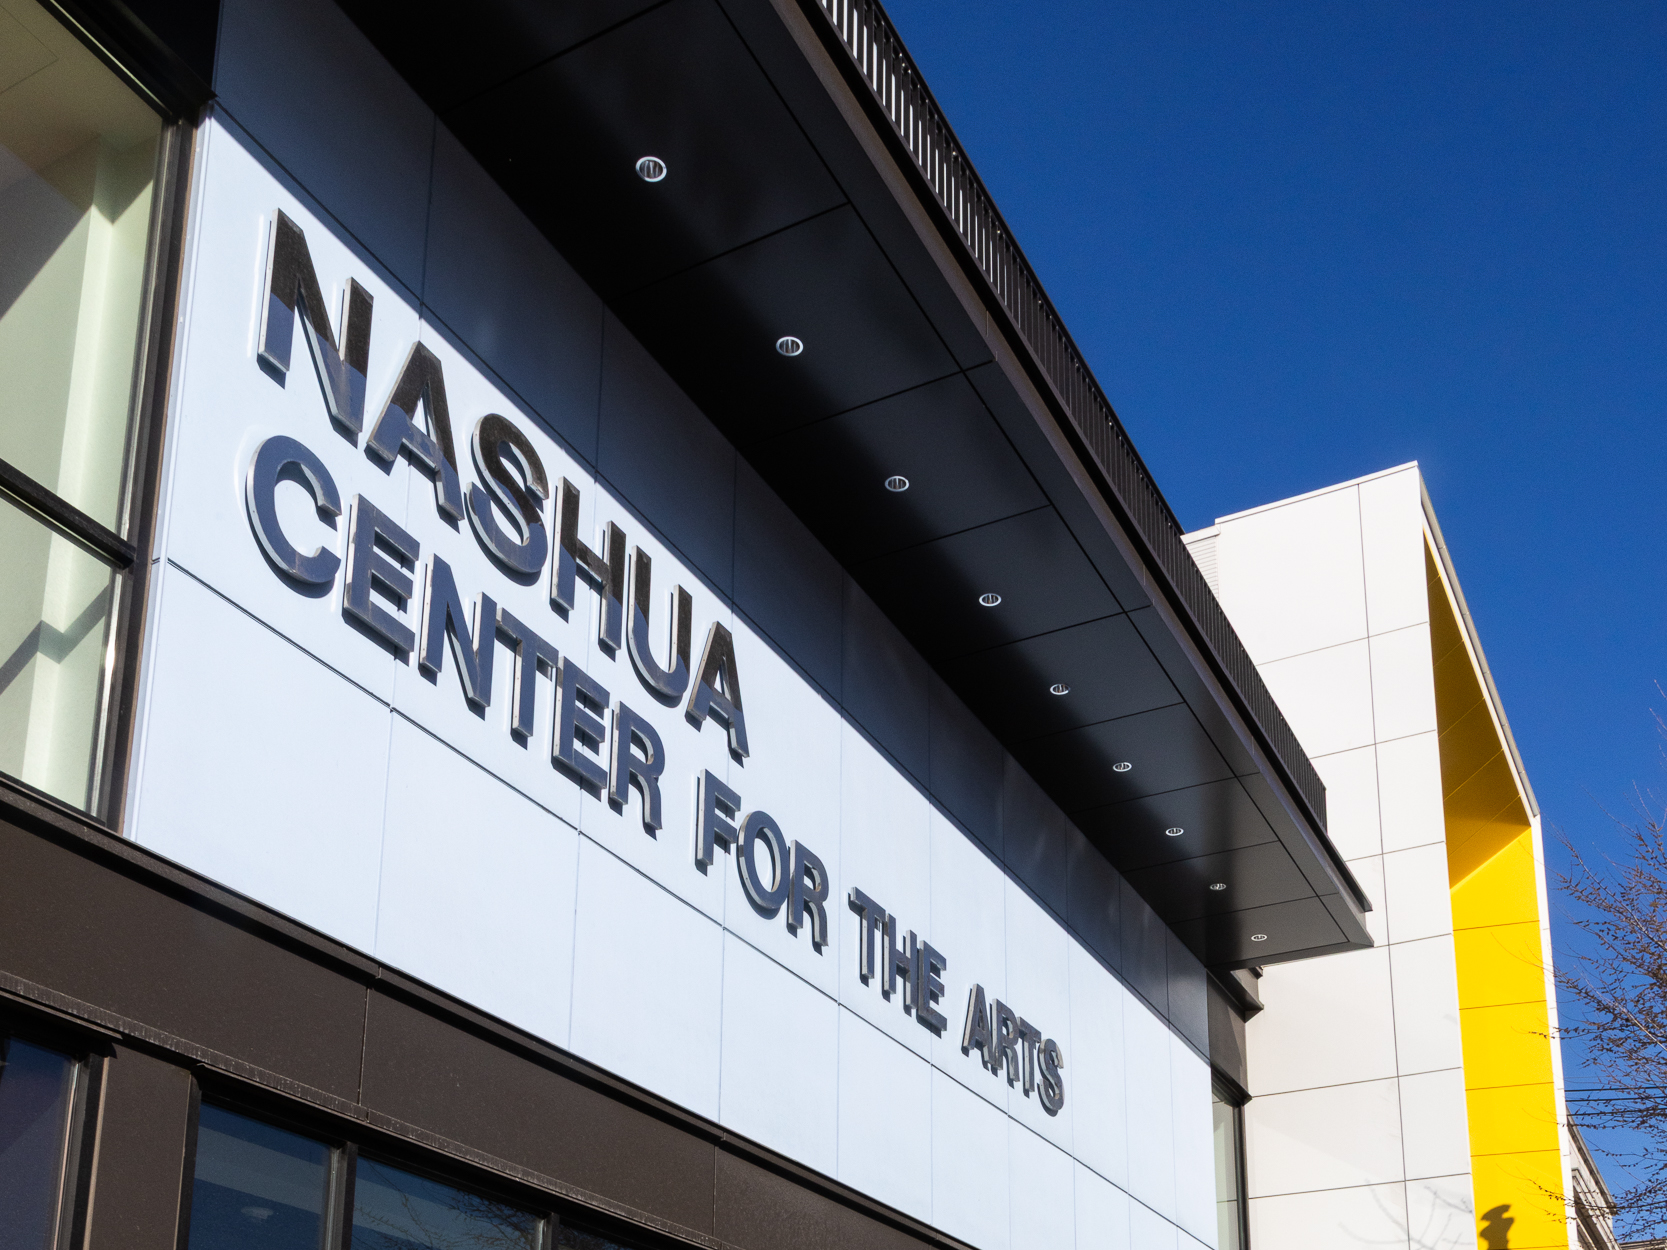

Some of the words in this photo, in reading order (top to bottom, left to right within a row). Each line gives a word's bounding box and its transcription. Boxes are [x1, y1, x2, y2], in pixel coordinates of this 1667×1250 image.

[246, 435, 666, 831] CENTER
[697, 769, 829, 947] FOR
[849, 886, 948, 1032] THE
[962, 983, 1065, 1111] ARTS
[257, 207, 749, 759] NASHUA
